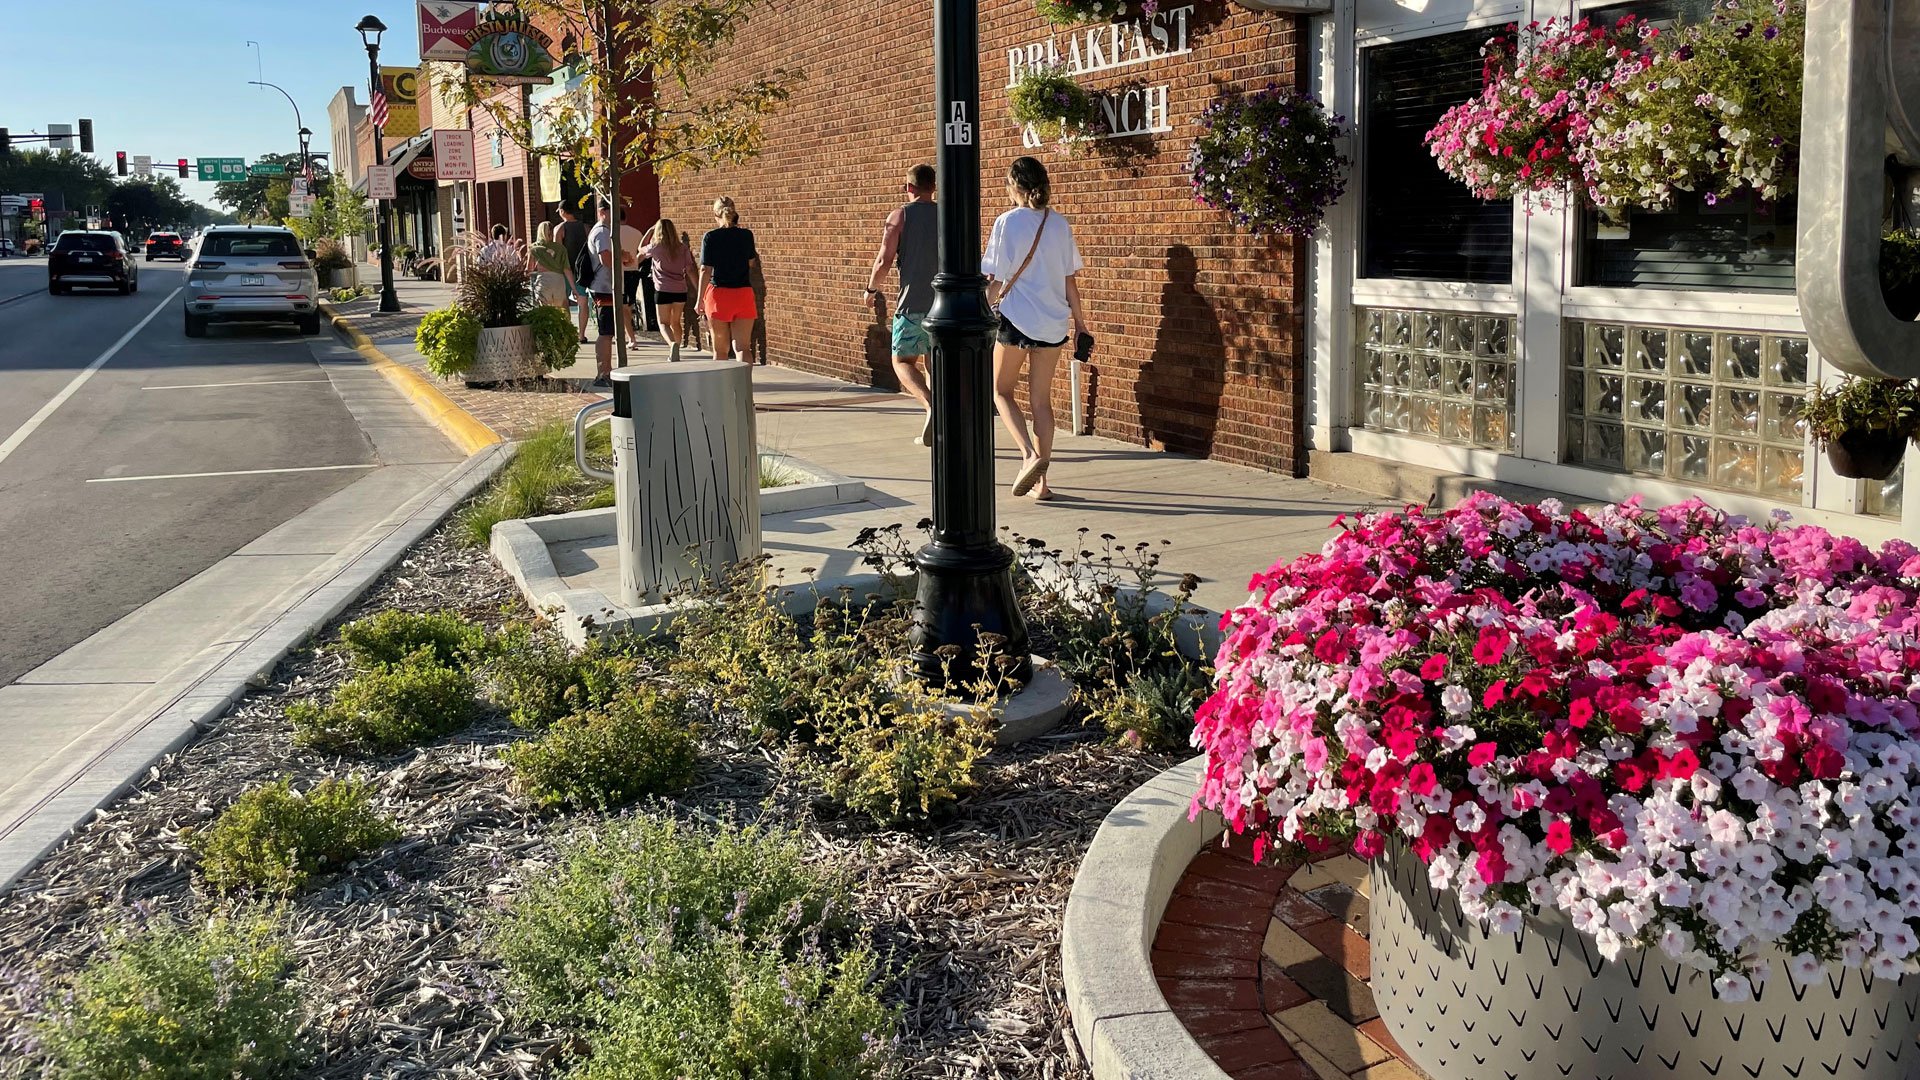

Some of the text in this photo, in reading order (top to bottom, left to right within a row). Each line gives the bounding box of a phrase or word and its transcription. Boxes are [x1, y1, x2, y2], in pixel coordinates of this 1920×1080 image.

[422, 24, 469, 35] Budweis
[954, 103, 964, 121] A
[1058, 85, 1173, 145] NCH
[949, 125, 969, 144] 15
